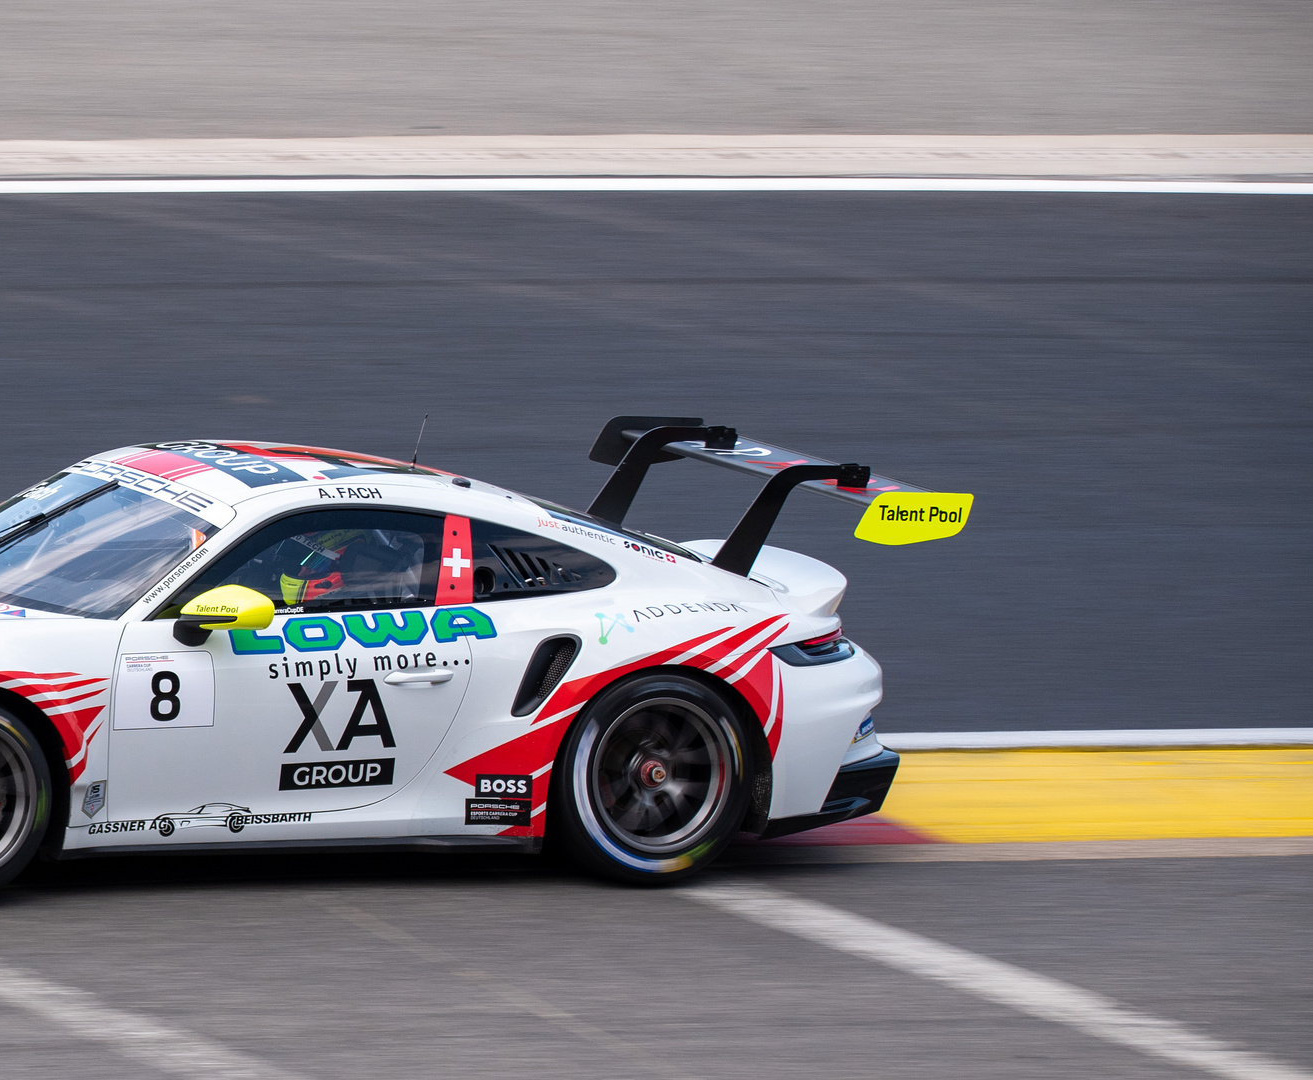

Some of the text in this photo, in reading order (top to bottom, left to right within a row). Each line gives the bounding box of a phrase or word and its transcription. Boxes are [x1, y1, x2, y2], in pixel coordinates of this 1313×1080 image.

[156, 441, 279, 476] GROUP
[72, 461, 214, 513] PORSCHE
[318, 487, 383, 500] A. FACH
[878, 504, 963, 524] Talent Pool
[537, 516, 617, 546] just authentic
[302, 537, 325, 553] TECH
[142, 546, 209, 604] www.porsche.com
[196, 605, 239, 614] Talent Pool
[632, 602, 748, 623] ADDENDA
[227, 606, 498, 655] LOWA
[268, 651, 470, 681] simply more...
[150, 670, 181, 722] 8
[282, 678, 397, 754] XA
[292, 762, 382, 787] GROUP
[480, 779, 527, 794] BOSS
[88, 812, 313, 835] GASSNER AG BEISSBARTH
